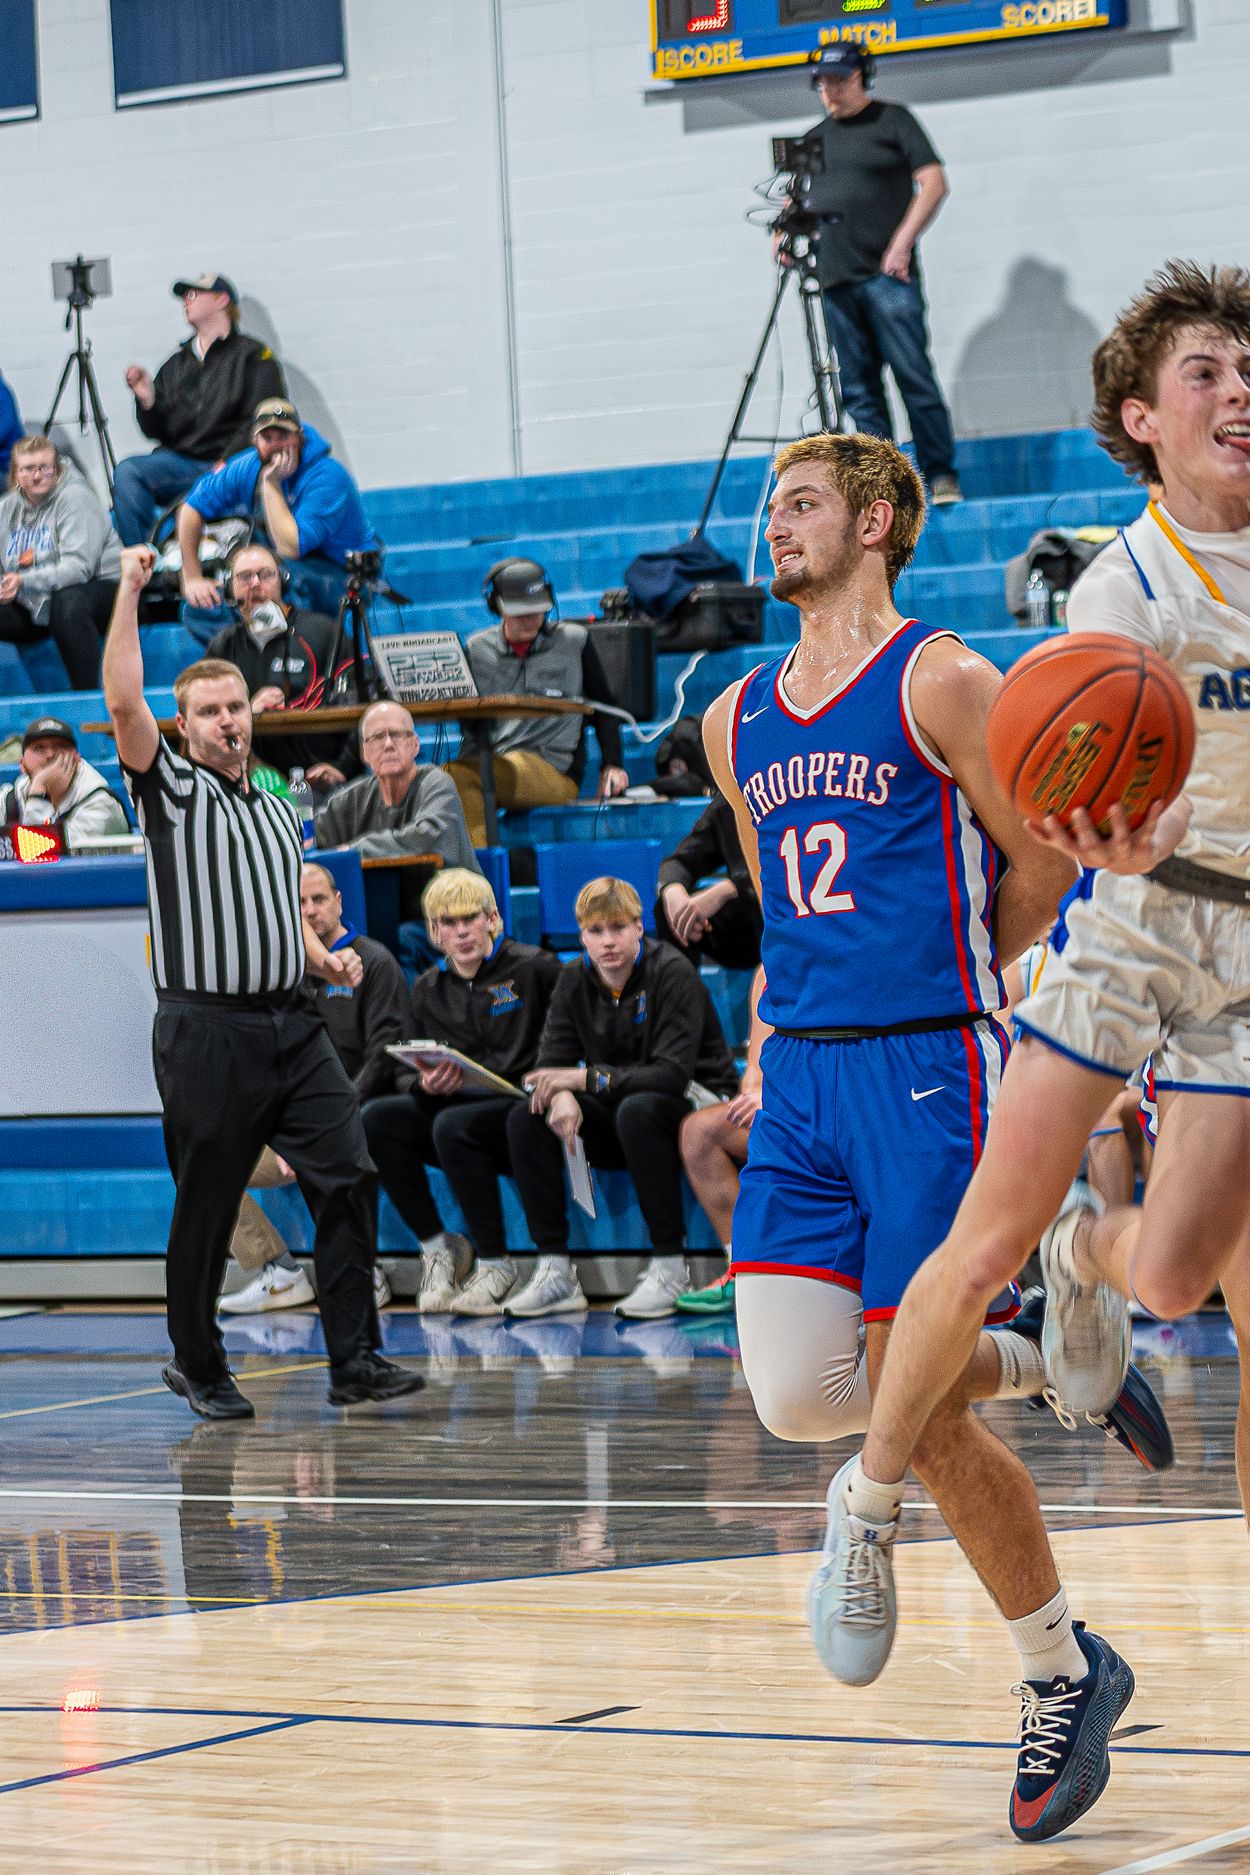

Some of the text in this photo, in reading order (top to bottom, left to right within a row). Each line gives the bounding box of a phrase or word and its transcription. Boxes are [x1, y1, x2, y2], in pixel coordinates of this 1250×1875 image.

[1002, 0, 1089, 28] SCORE
[819, 20, 897, 46] MATCH
[664, 40, 744, 69] SCORE
[743, 752, 898, 825] TROOPERS
[780, 820, 856, 917] 12
